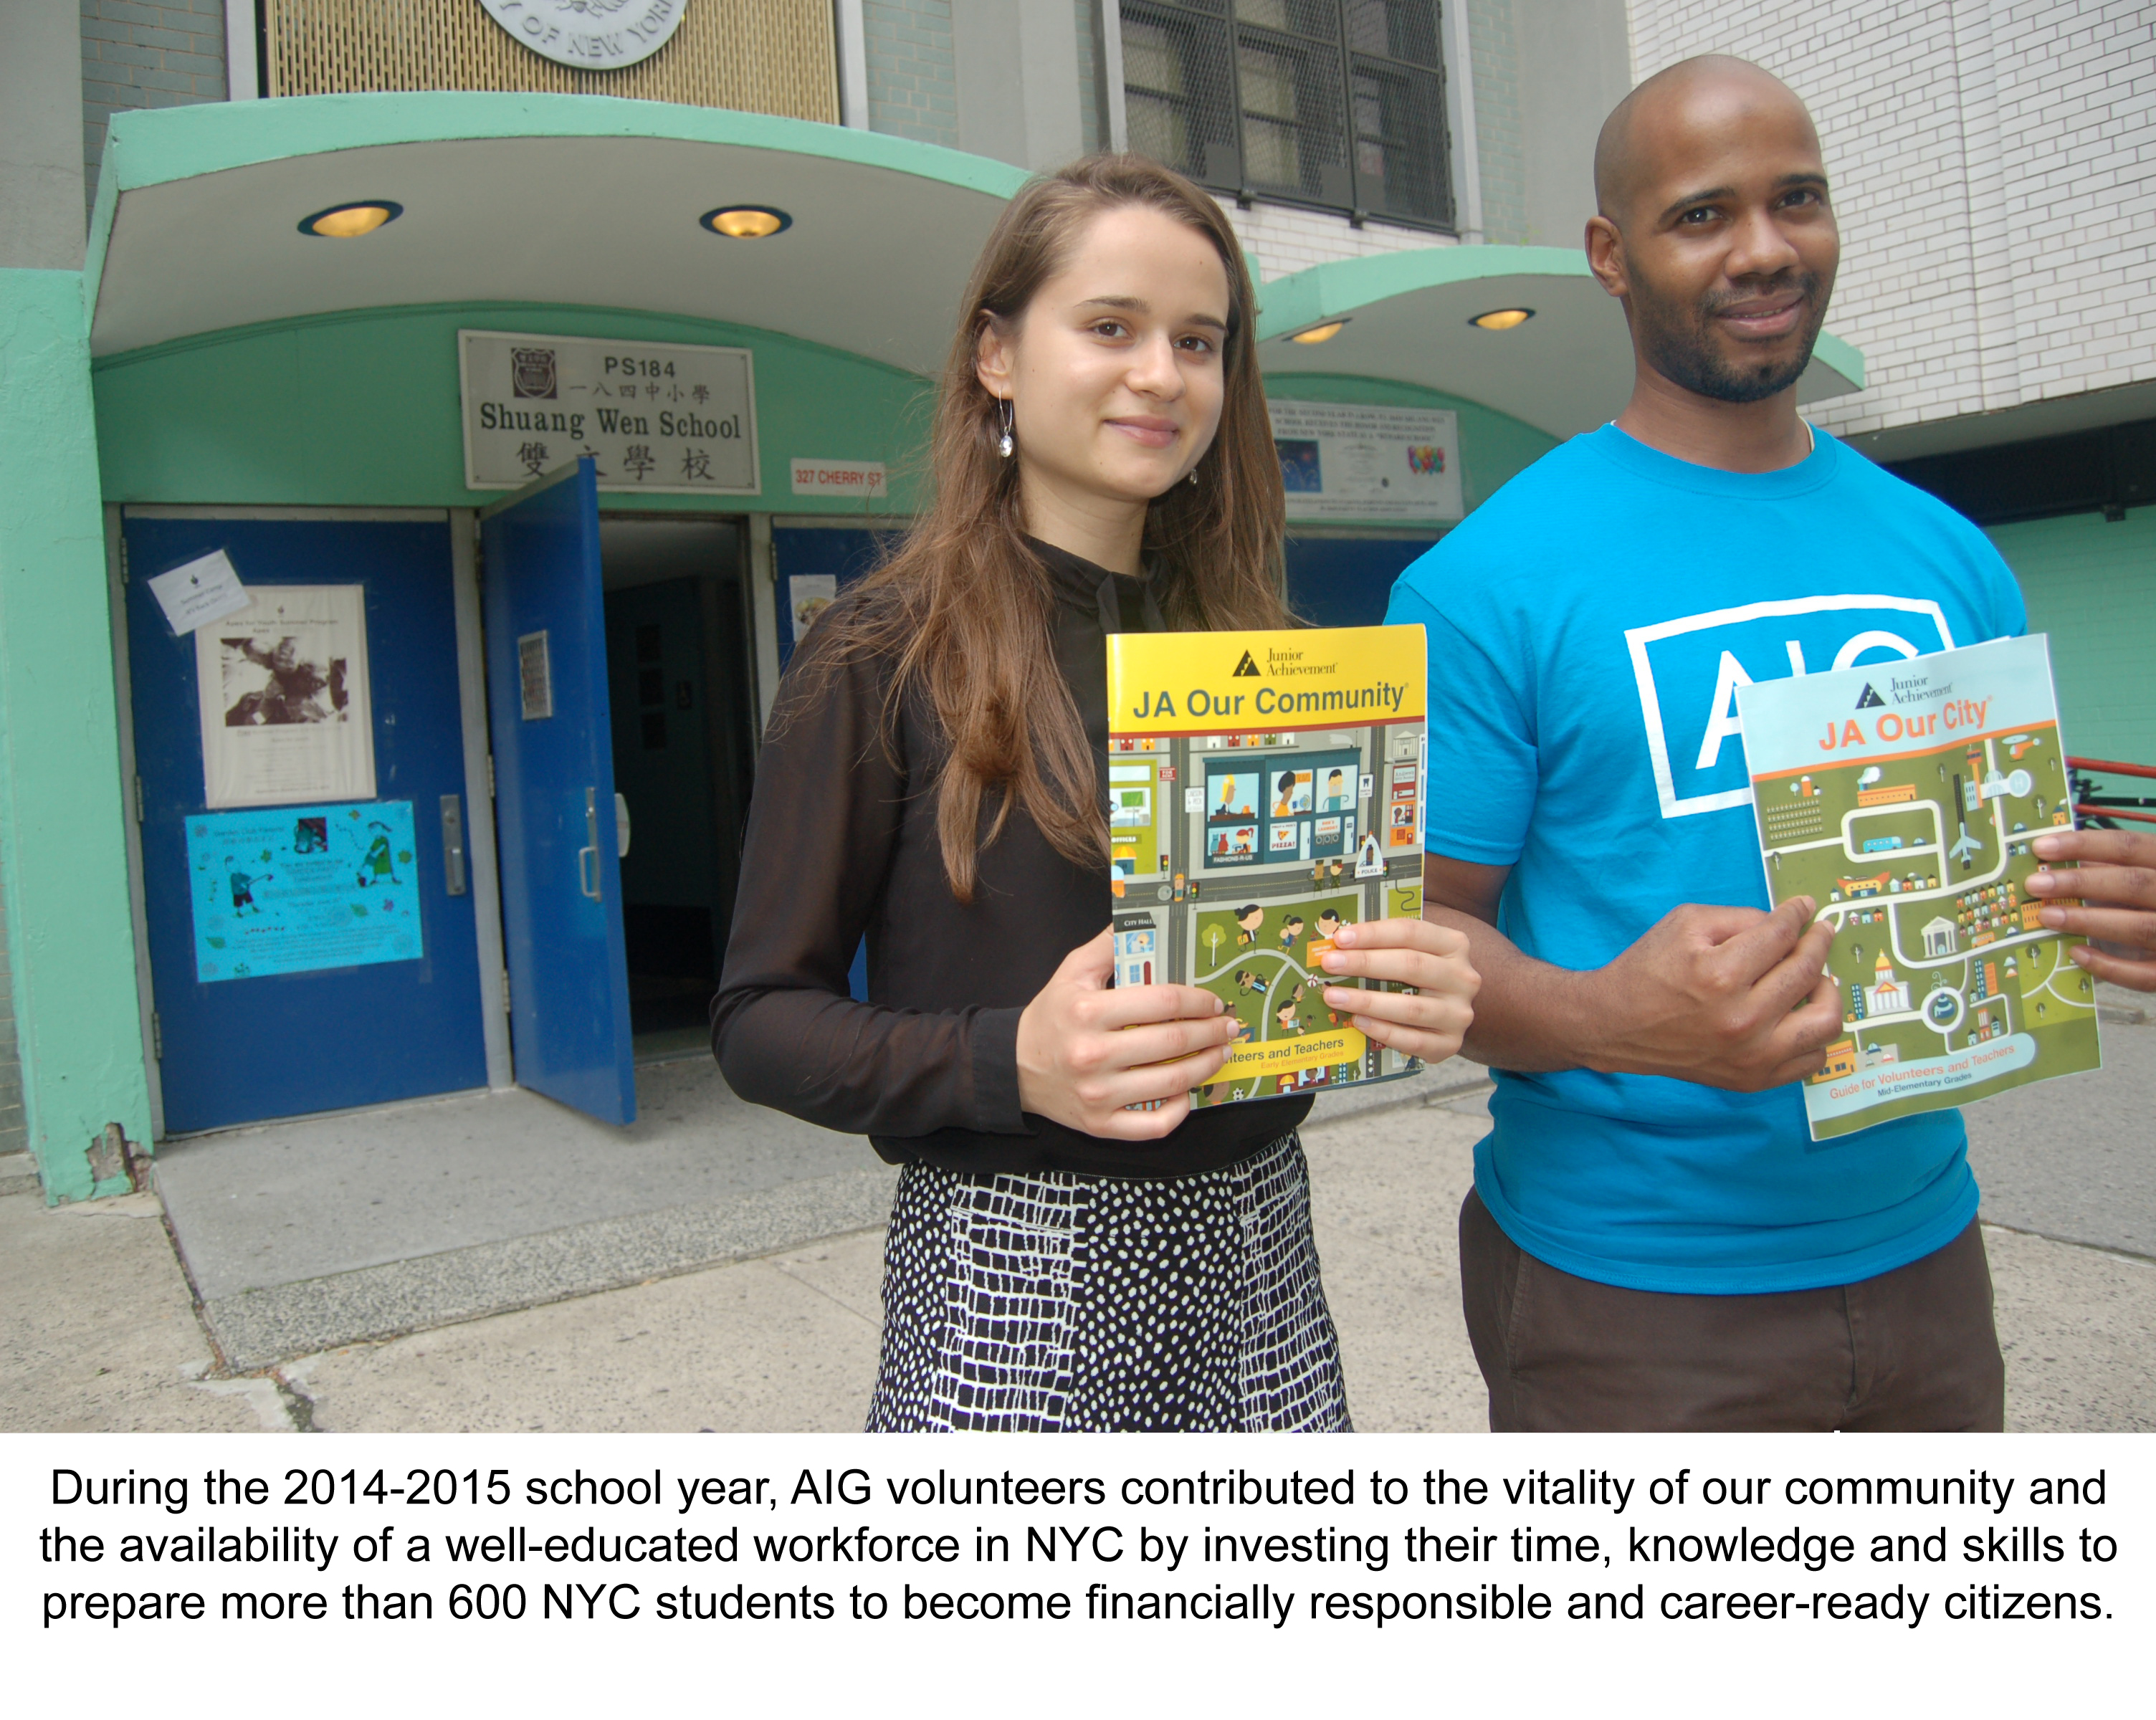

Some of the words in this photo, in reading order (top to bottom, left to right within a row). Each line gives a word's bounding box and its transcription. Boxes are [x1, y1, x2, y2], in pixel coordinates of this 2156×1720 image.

[567, 33, 624, 57] NEW
[604, 357, 676, 378] PS184
[569, 381, 710, 405] 一八四中小學
[480, 402, 586, 440] Shuang
[596, 408, 649, 436] Wen
[659, 411, 741, 439] School
[796, 469, 815, 484] 327
[818, 469, 865, 485] CHERRY
[867, 472, 882, 486] ST
[1267, 648, 1304, 664] Junior
[1267, 662, 1337, 677] Achievement
[1890, 674, 1928, 692] Junior
[1892, 683, 1952, 705] Achievement
[1133, 691, 1176, 719] JA
[1187, 689, 1245, 717] Our
[1256, 682, 1404, 715] Community
[1818, 719, 1866, 751] JA
[1876, 713, 1937, 742] Our
[1942, 699, 1988, 730] City
[1225, 1051, 1264, 1064] nteers
[1268, 1046, 1291, 1059] and
[1294, 1039, 1344, 1056] Teachers
[1281, 1055, 1318, 1067] Elementary
[1320, 1051, 1344, 1060] Grades
[1829, 1083, 1860, 1099] Guide
[1861, 1078, 1875, 1090] for
[1877, 1065, 1945, 1085] Volunteers
[1947, 1059, 1969, 1074] and
[1971, 1043, 2016, 1066] Teachers
[1877, 1078, 1942, 1097] Mid-Elementary
[1944, 1072, 1973, 1085] Grades
